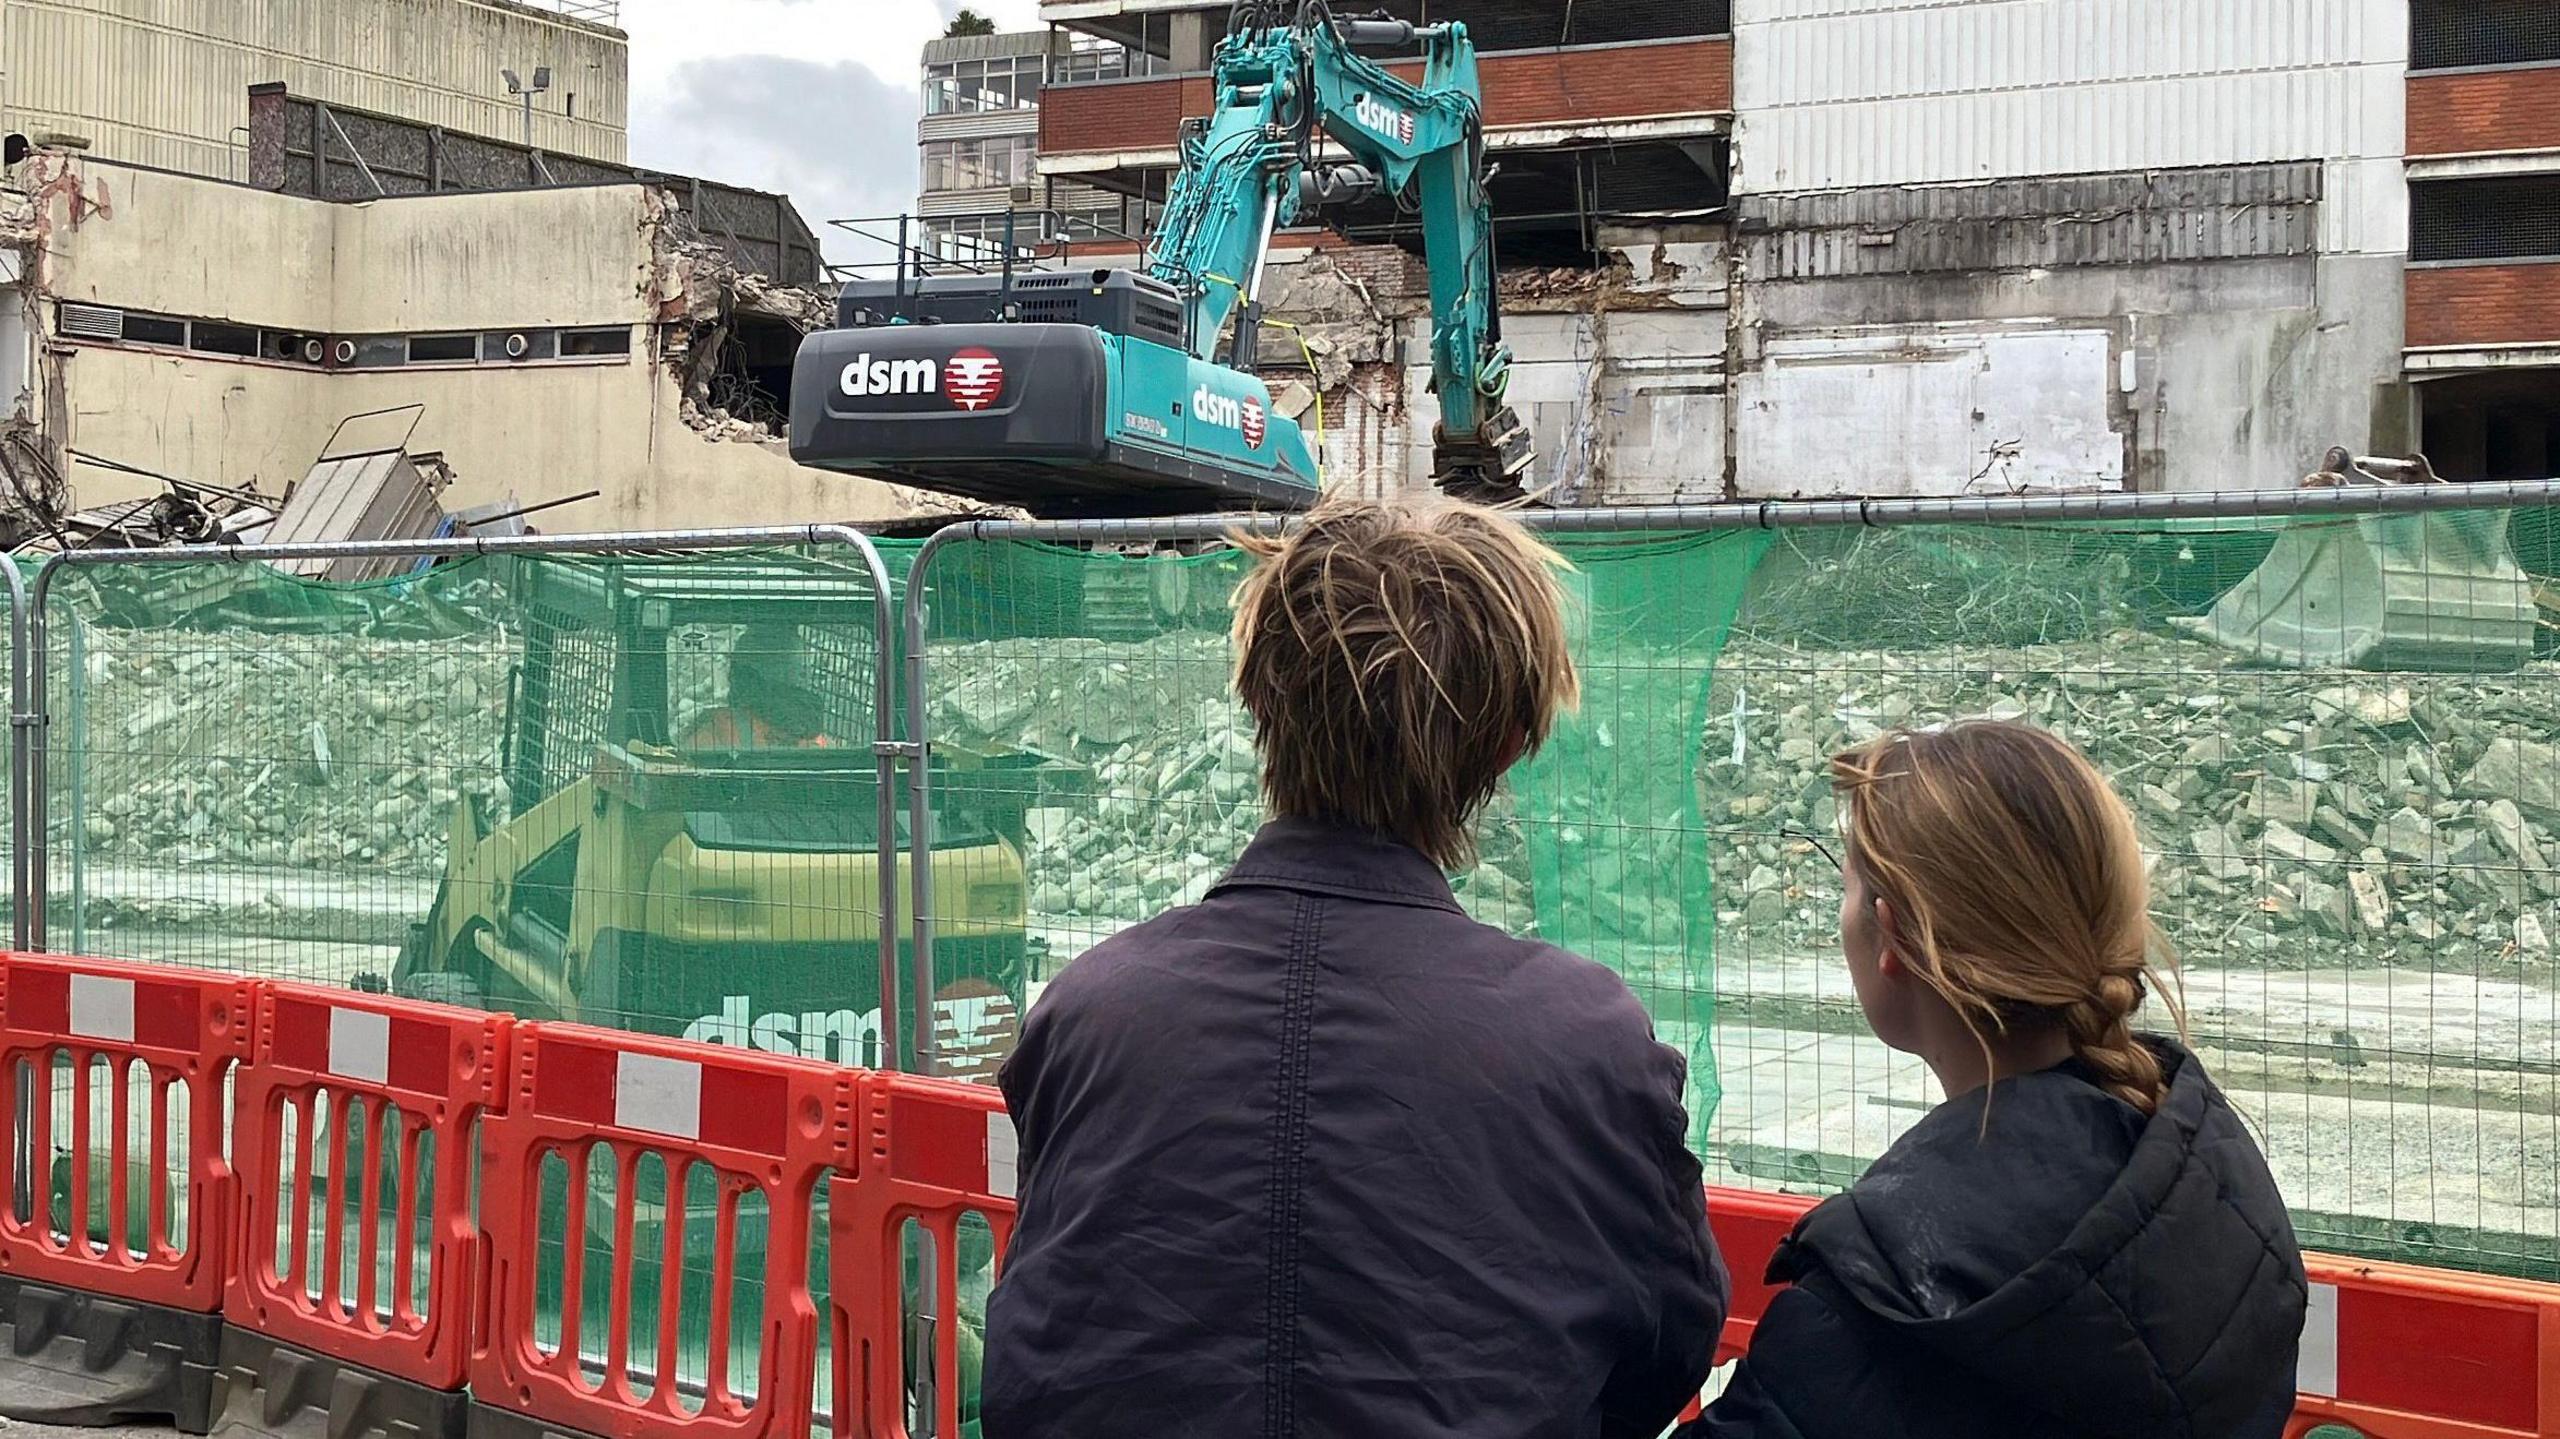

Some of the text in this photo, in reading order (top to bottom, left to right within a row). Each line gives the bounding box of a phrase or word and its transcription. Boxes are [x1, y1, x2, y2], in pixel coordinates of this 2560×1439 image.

[1356, 91, 1398, 140] dsm
[840, 353, 937, 395] dsm
[1193, 384, 1240, 430] dsm
